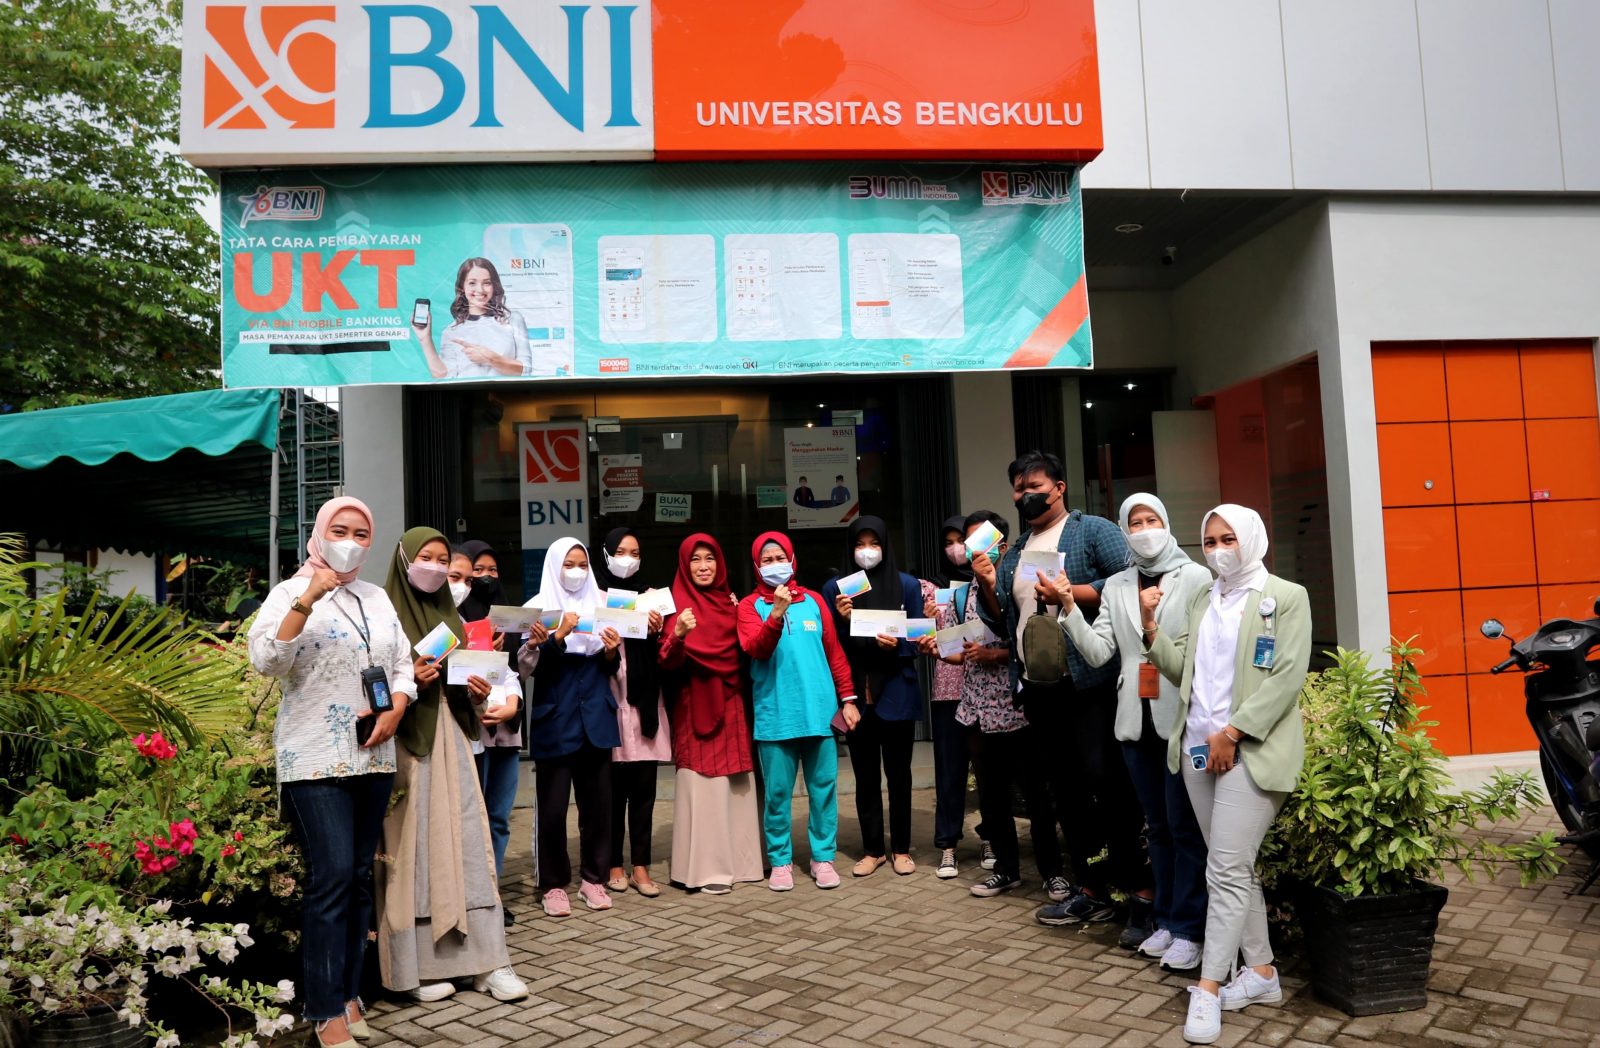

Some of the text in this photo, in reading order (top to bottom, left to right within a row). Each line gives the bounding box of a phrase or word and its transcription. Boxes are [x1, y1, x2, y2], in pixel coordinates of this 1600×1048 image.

[360, 4, 643, 132] BNI
[696, 101, 1083, 126] UNIVERSITAS BENGKULU
[1011, 171, 1069, 200] BNI
[272, 191, 317, 210] BNI
[229, 234, 421, 249] TATA CARA PEMBAYARAN
[523, 259, 545, 269] BNI
[233, 249, 415, 313] UKT
[247, 316, 402, 329] VIA BNI MOBILE BANKING
[335, 330, 373, 339] SEMERTER
[636, 363, 649, 371] BNI
[651, 362, 681, 371] terdaftar
[778, 361, 792, 369] BNI
[793, 360, 832, 369] merupakan
[834, 360, 859, 368] peserta
[659, 495, 689, 506] BUKA
[527, 499, 584, 526] BNI
[660, 507, 687, 519] Open
